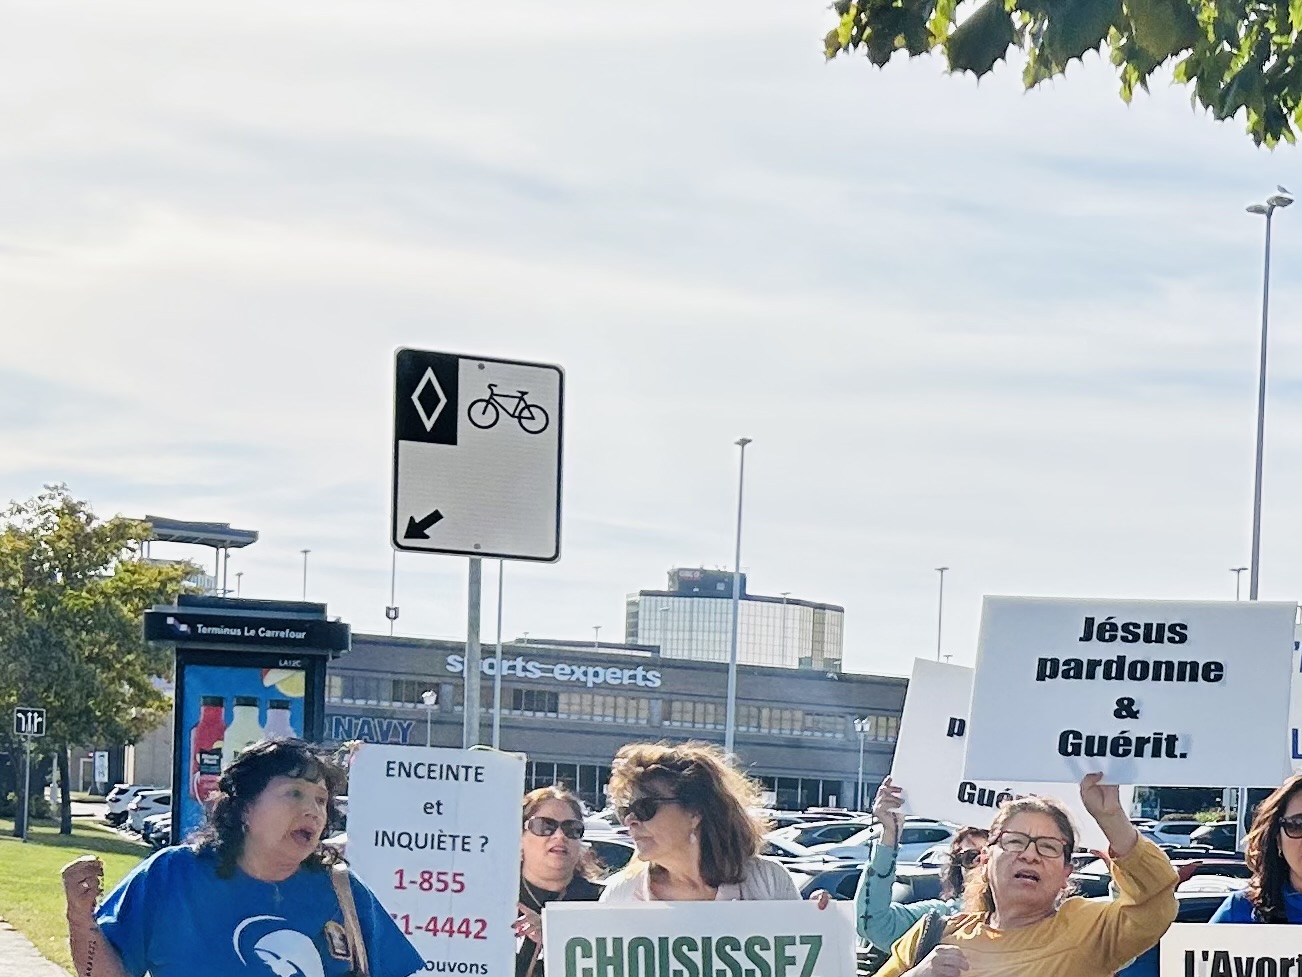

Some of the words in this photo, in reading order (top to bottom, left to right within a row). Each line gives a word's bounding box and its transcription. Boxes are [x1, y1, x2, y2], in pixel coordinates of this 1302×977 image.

[197, 624, 241, 637] Terminus
[244, 627, 256, 637] Le
[258, 627, 306, 640] Carrefour
[1079, 616, 1188, 644] Jésus
[445, 655, 541, 679] sorts
[553, 663, 662, 688] experts
[1035, 655, 1224, 683] pardonne
[1113, 696, 1140, 719] &
[331, 716, 416, 744] NAVY
[1057, 729, 1188, 759] Guérit.
[385, 760, 485, 783] ENCEINTE
[423, 800, 443, 815] et
[958, 782, 1038, 809] Gué
[374, 829, 471, 852] INQUIÈTE
[479, 835, 489, 853] ?
[393, 868, 466, 894] 1-855
[390, 913, 488, 940] 1-4442
